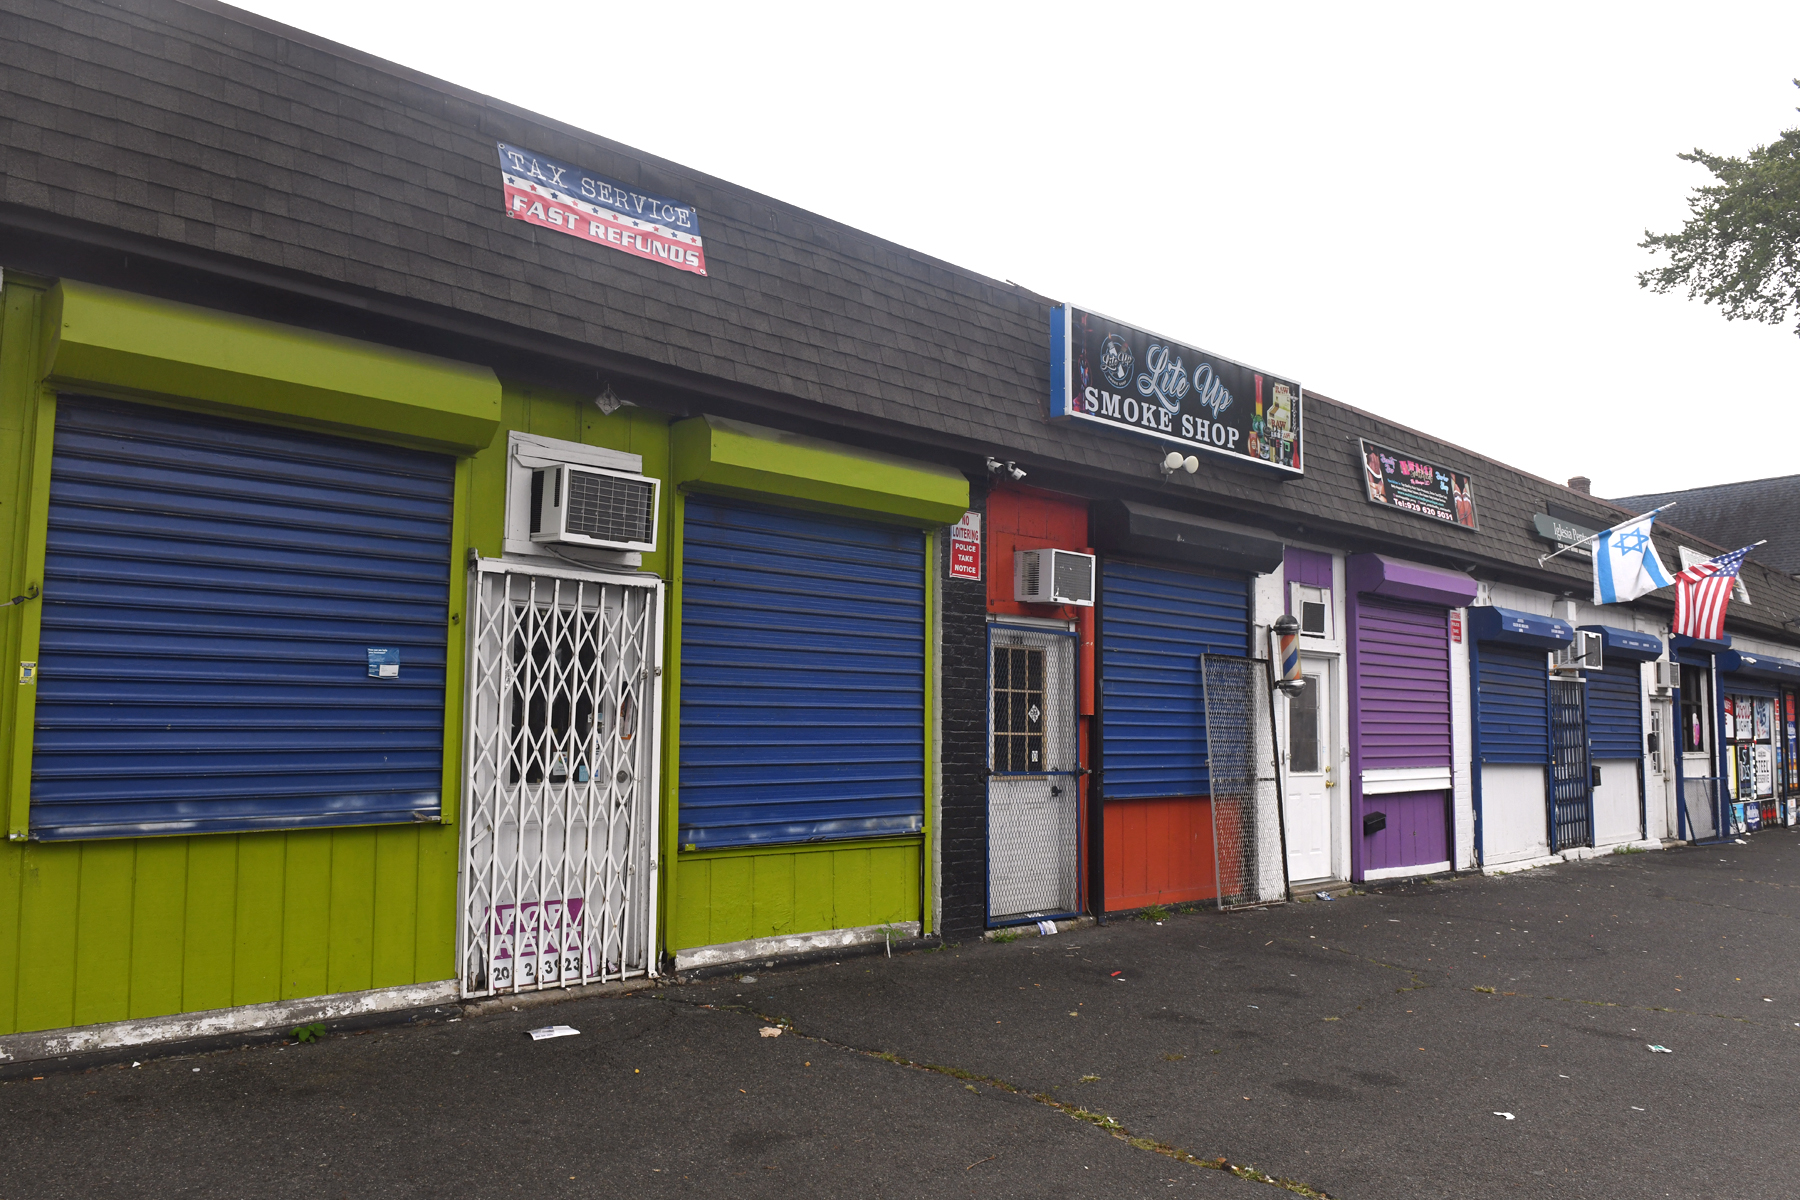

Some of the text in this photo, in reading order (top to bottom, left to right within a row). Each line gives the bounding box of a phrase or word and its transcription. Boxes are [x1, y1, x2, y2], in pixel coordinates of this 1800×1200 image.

[508, 150, 691, 228] TAX SERVICE
[511, 194, 700, 268] FAST REFUNDS
[1137, 343, 1233, 419] Lite Up
[1275, 385, 1289, 395] RAW
[1084, 386, 1240, 449] SMOKE SHOP
[1271, 418, 1287, 430] RAW
[962, 515, 969, 526] NO
[1422, 506, 1436, 516] 620
[1437, 511, 1453, 521] 5031
[953, 527, 979, 541] LOITERING
[1553, 522, 1573, 540] Iglesia
[955, 543, 976, 552] POLICE
[958, 554, 973, 562] TAKE
[954, 564, 976, 573] NOTICE
